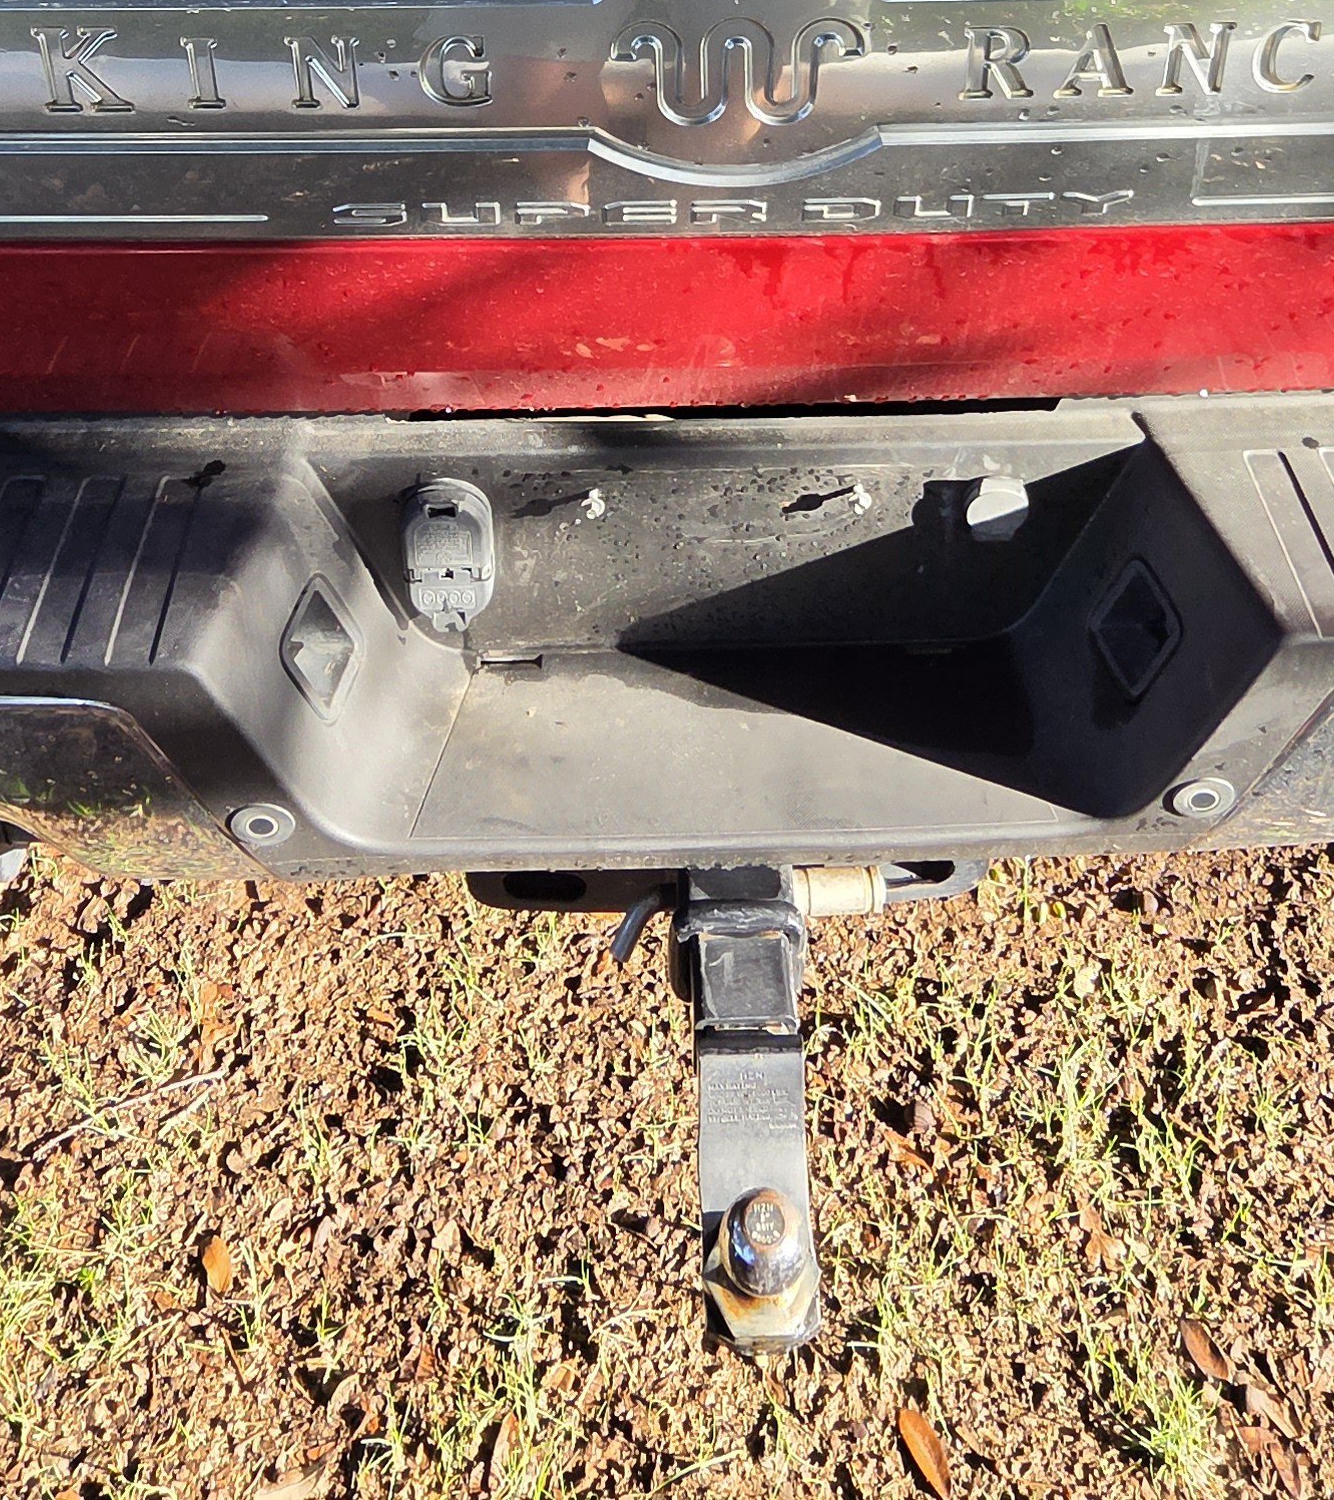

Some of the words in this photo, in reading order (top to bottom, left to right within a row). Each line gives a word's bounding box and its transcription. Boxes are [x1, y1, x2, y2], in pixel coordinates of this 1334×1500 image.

[29, 25, 495, 114] KING
[330, 199, 771, 228] SUPER
[798, 190, 1135, 223] DUTY
